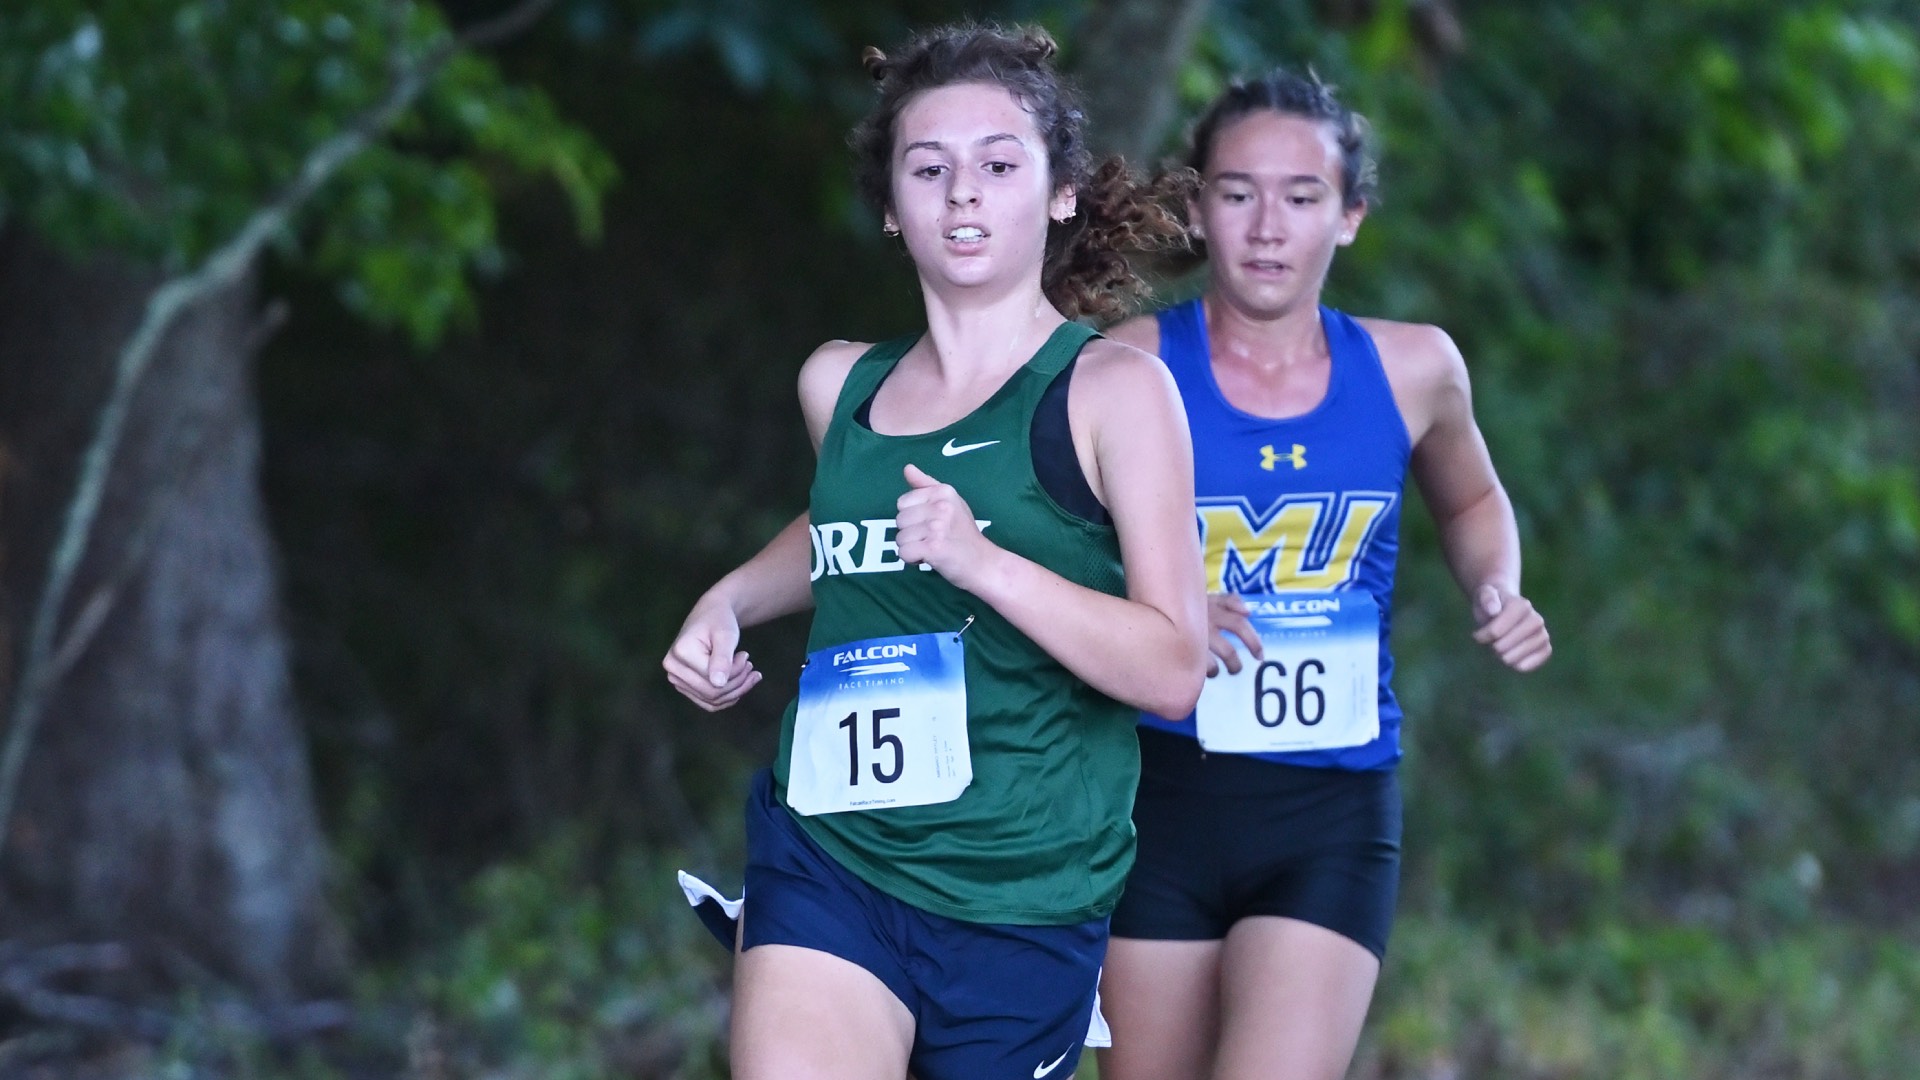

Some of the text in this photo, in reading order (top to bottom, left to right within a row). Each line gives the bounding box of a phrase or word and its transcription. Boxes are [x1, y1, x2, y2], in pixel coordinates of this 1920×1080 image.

[810, 518, 991, 582] RE
[1195, 491, 1397, 596] MU
[1243, 597, 1340, 616] FALCON
[833, 643, 917, 667] FALCON
[865, 677, 905, 687] TIMING
[1254, 658, 1326, 728] 66
[839, 707, 904, 786] 15
